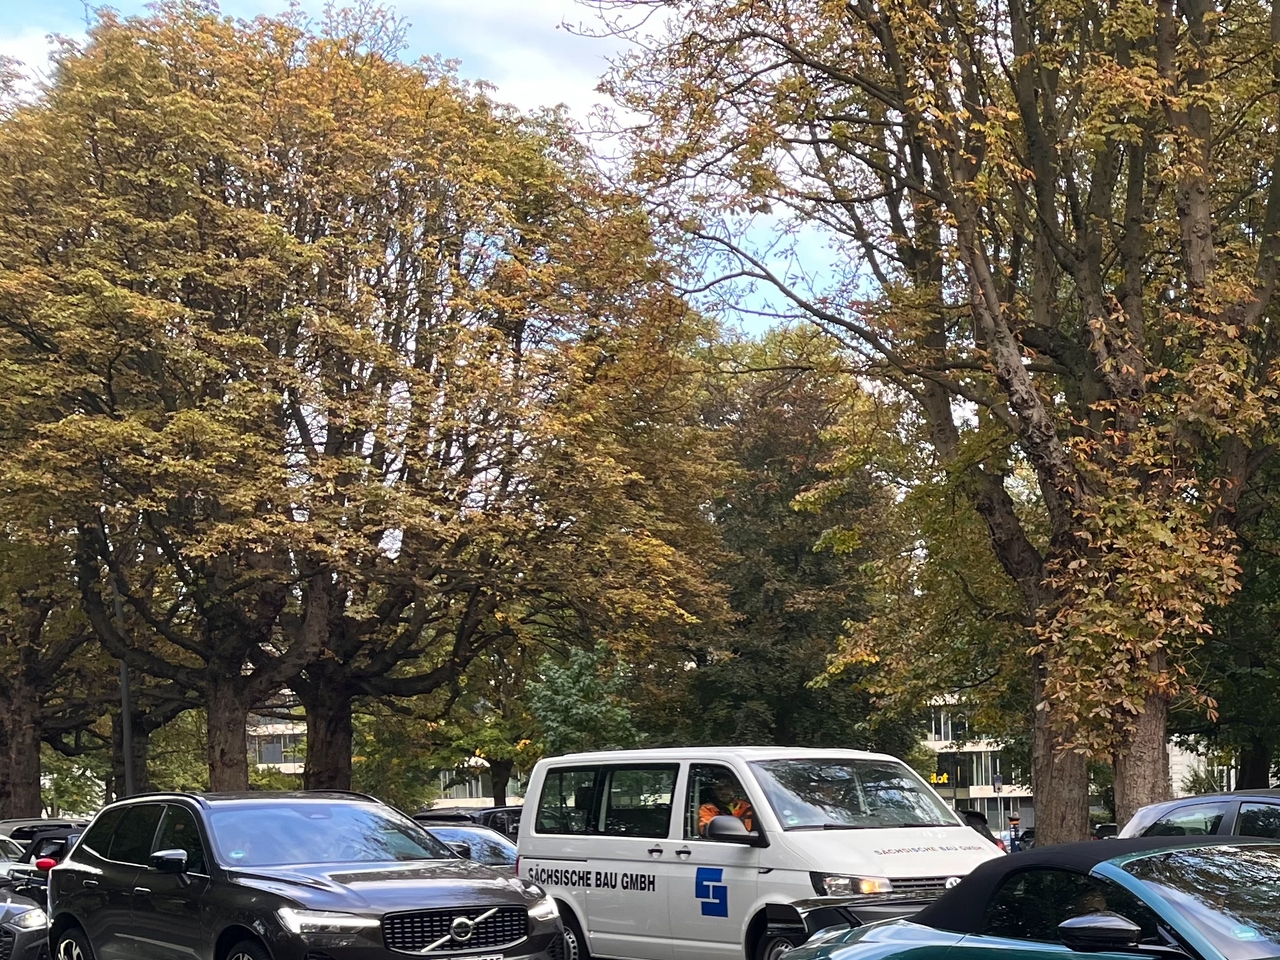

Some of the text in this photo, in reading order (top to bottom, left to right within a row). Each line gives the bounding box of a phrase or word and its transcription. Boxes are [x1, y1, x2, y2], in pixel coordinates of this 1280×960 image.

[528, 864, 656, 892] SÄCHSISCHE BAU GMBH
